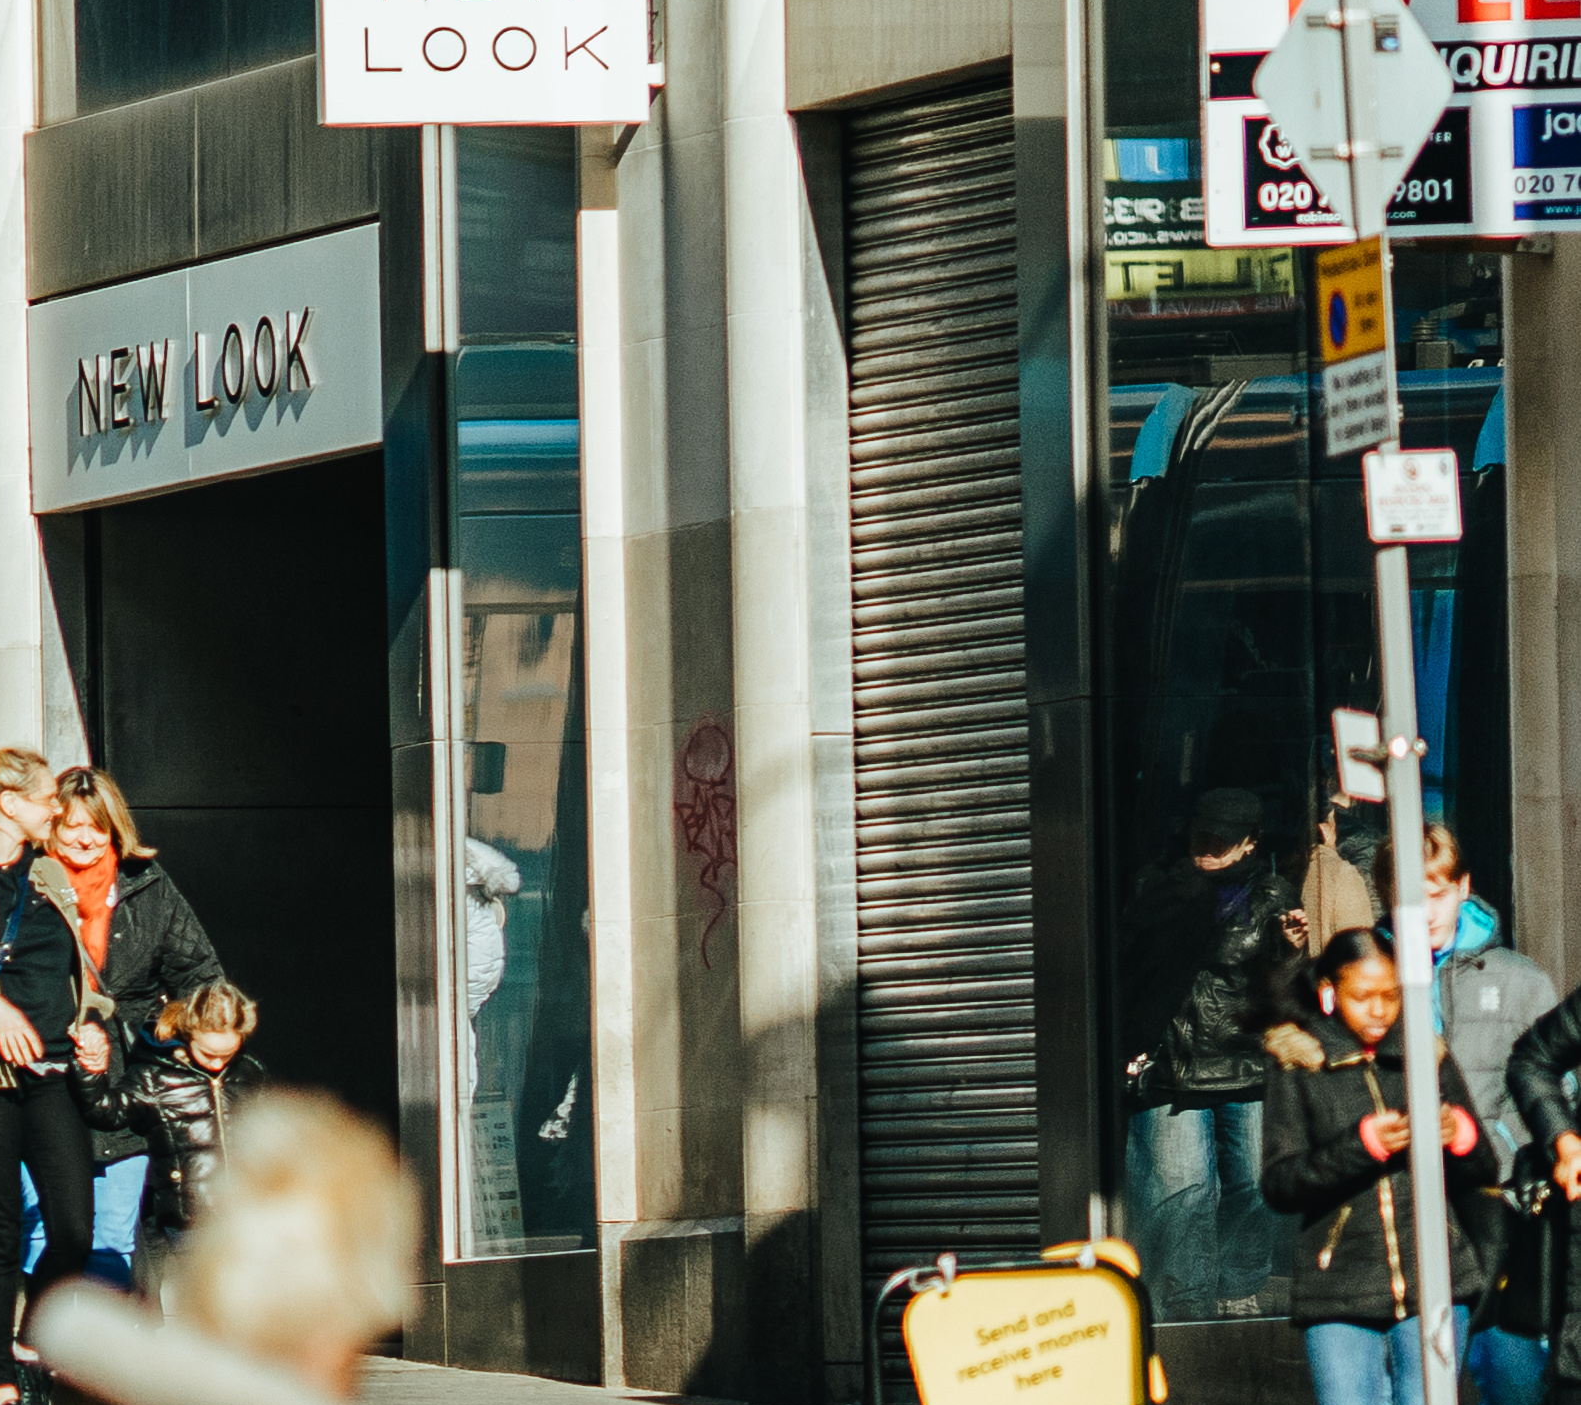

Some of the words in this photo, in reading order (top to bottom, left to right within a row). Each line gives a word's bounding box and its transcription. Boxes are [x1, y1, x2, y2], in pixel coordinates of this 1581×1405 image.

[364, 26, 610, 72] LOOK
[1259, 182, 1313, 209] 020
[1514, 174, 1555, 194] 020
[77, 339, 171, 437] NEW
[194, 306, 315, 413] LOOK
[976, 1313, 1030, 1347] Send
[1033, 1297, 1077, 1328] and
[957, 1345, 1033, 1382] receive
[1036, 1318, 1110, 1356] money
[1013, 1363, 1064, 1392] here
